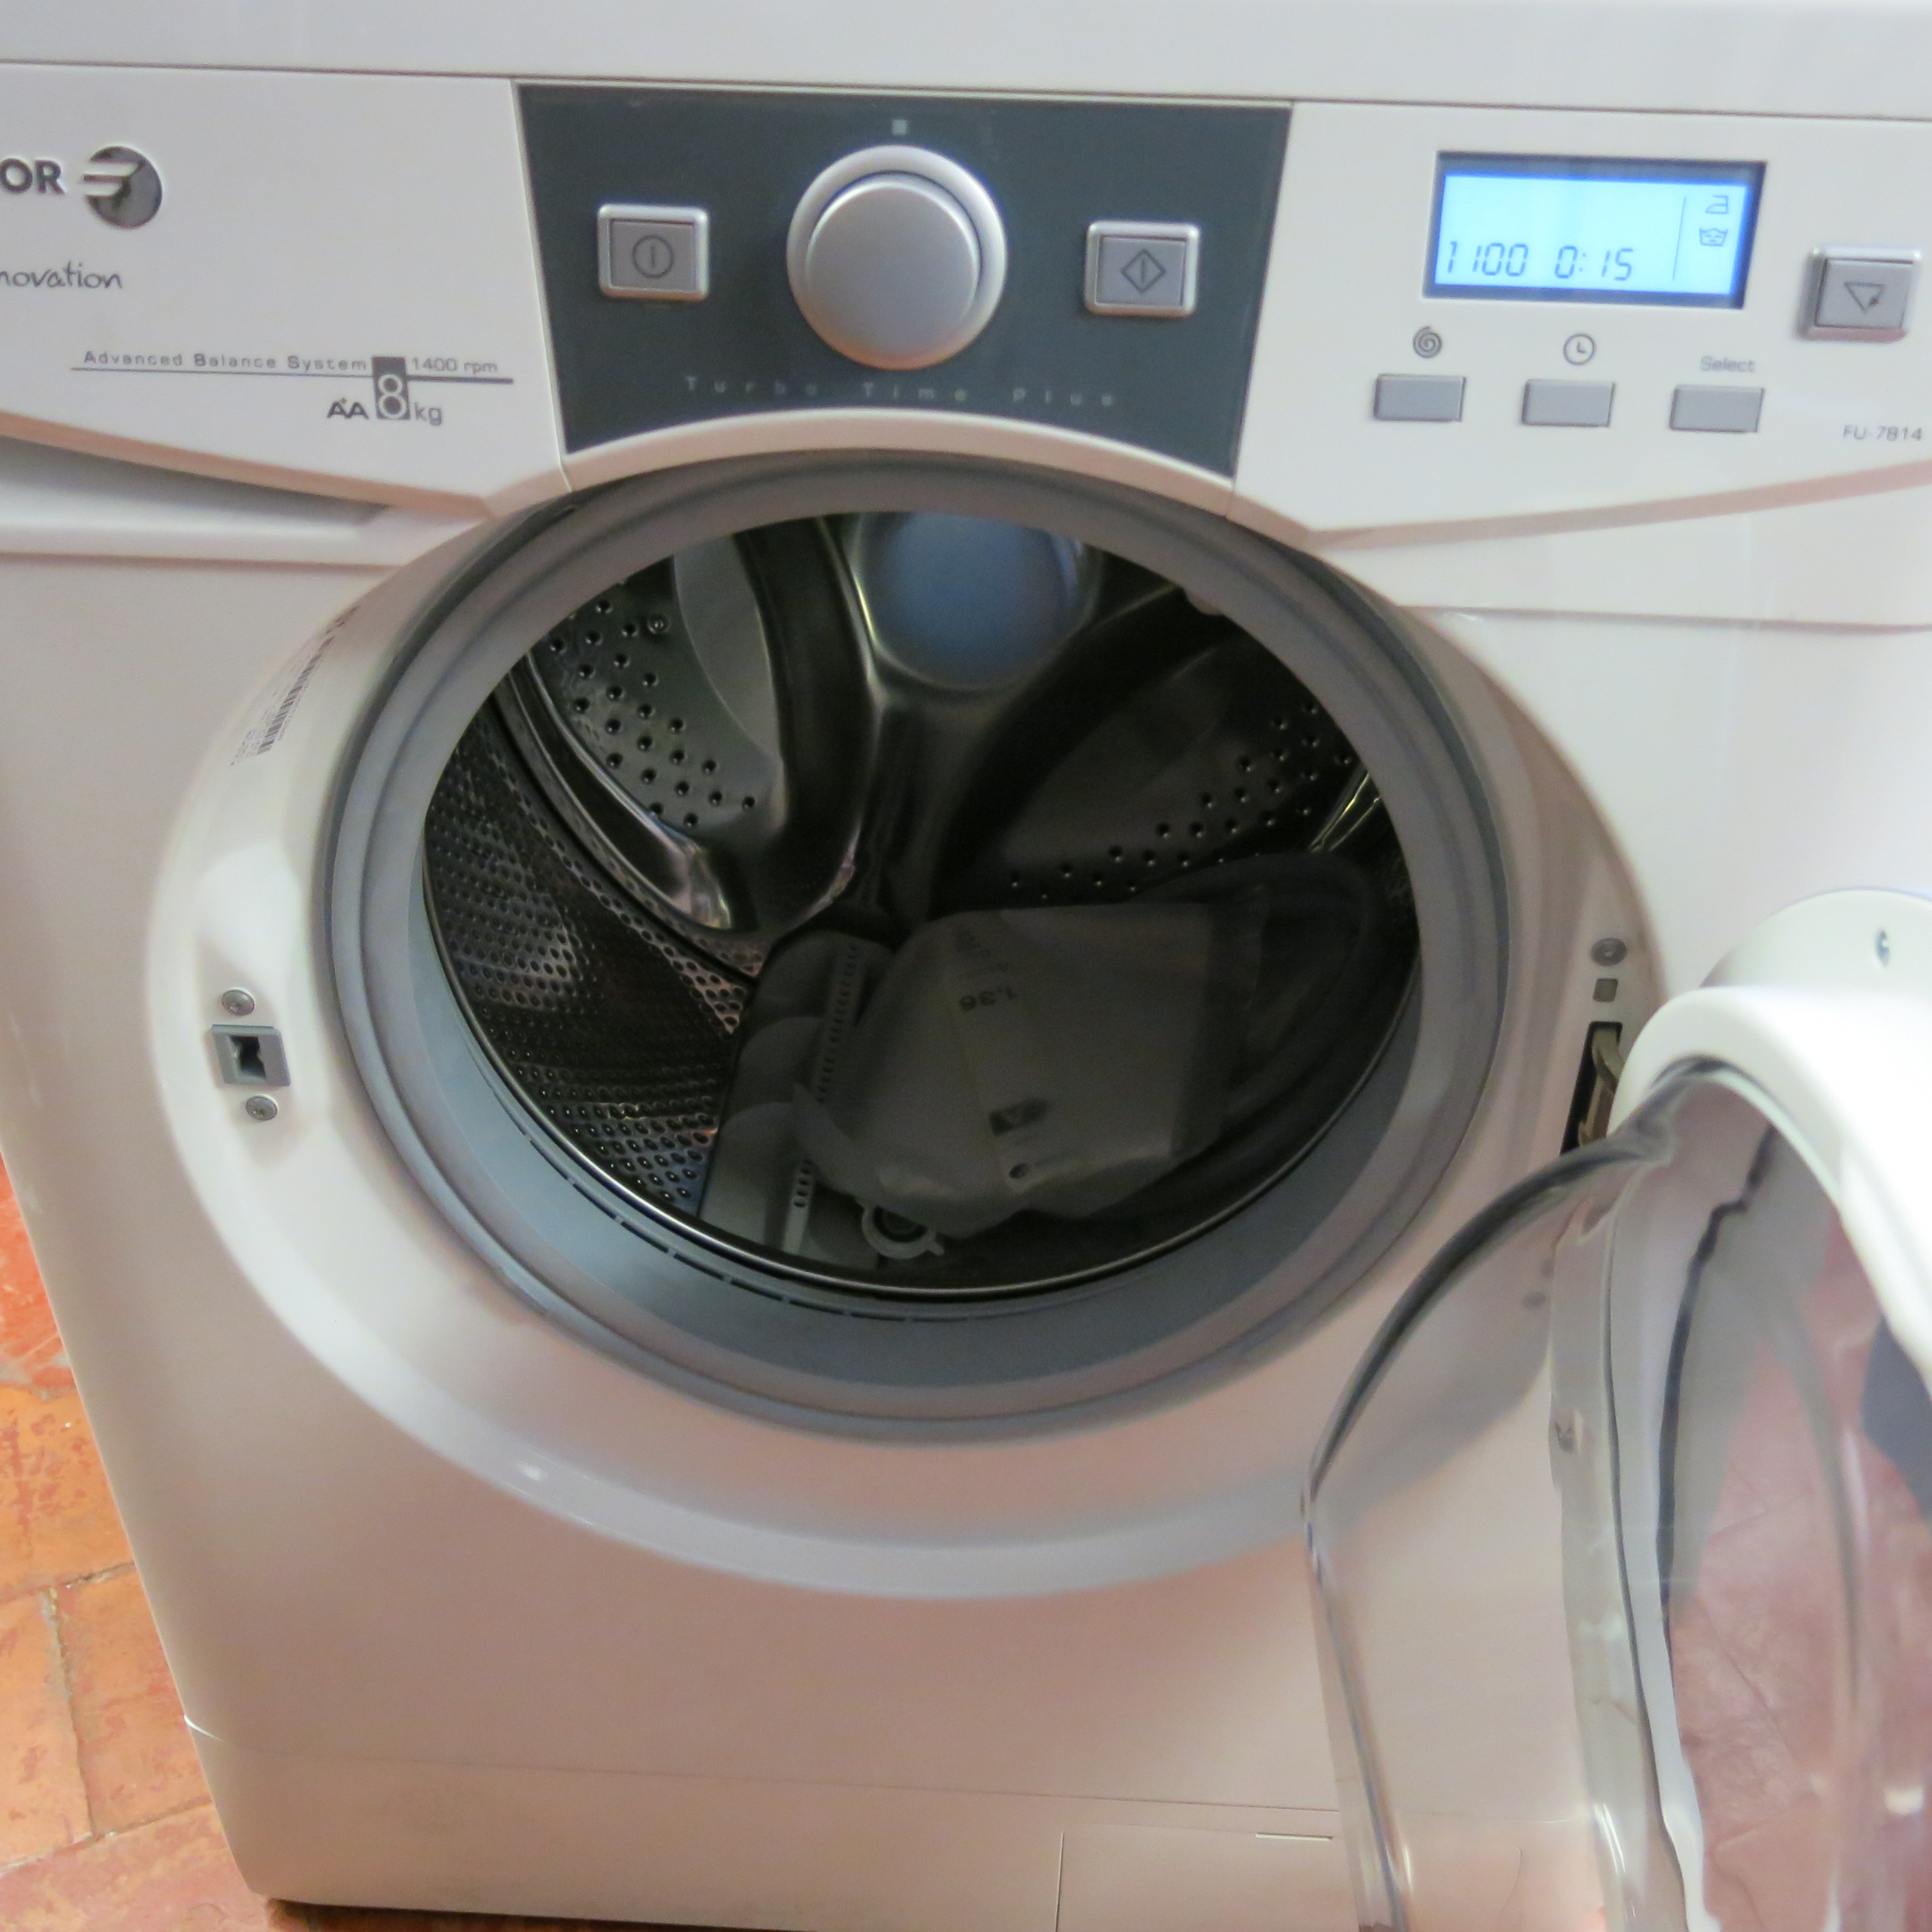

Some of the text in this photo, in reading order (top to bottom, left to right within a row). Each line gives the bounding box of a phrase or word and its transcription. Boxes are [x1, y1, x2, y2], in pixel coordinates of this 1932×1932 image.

[1554, 245, 1634, 282] 0:15
[84, 351, 498, 374] Advanced Balance System 1400 rpm
[1700, 355, 1756, 373] Select
[378, 374, 406, 419] 8
[414, 402, 442, 426] kg
